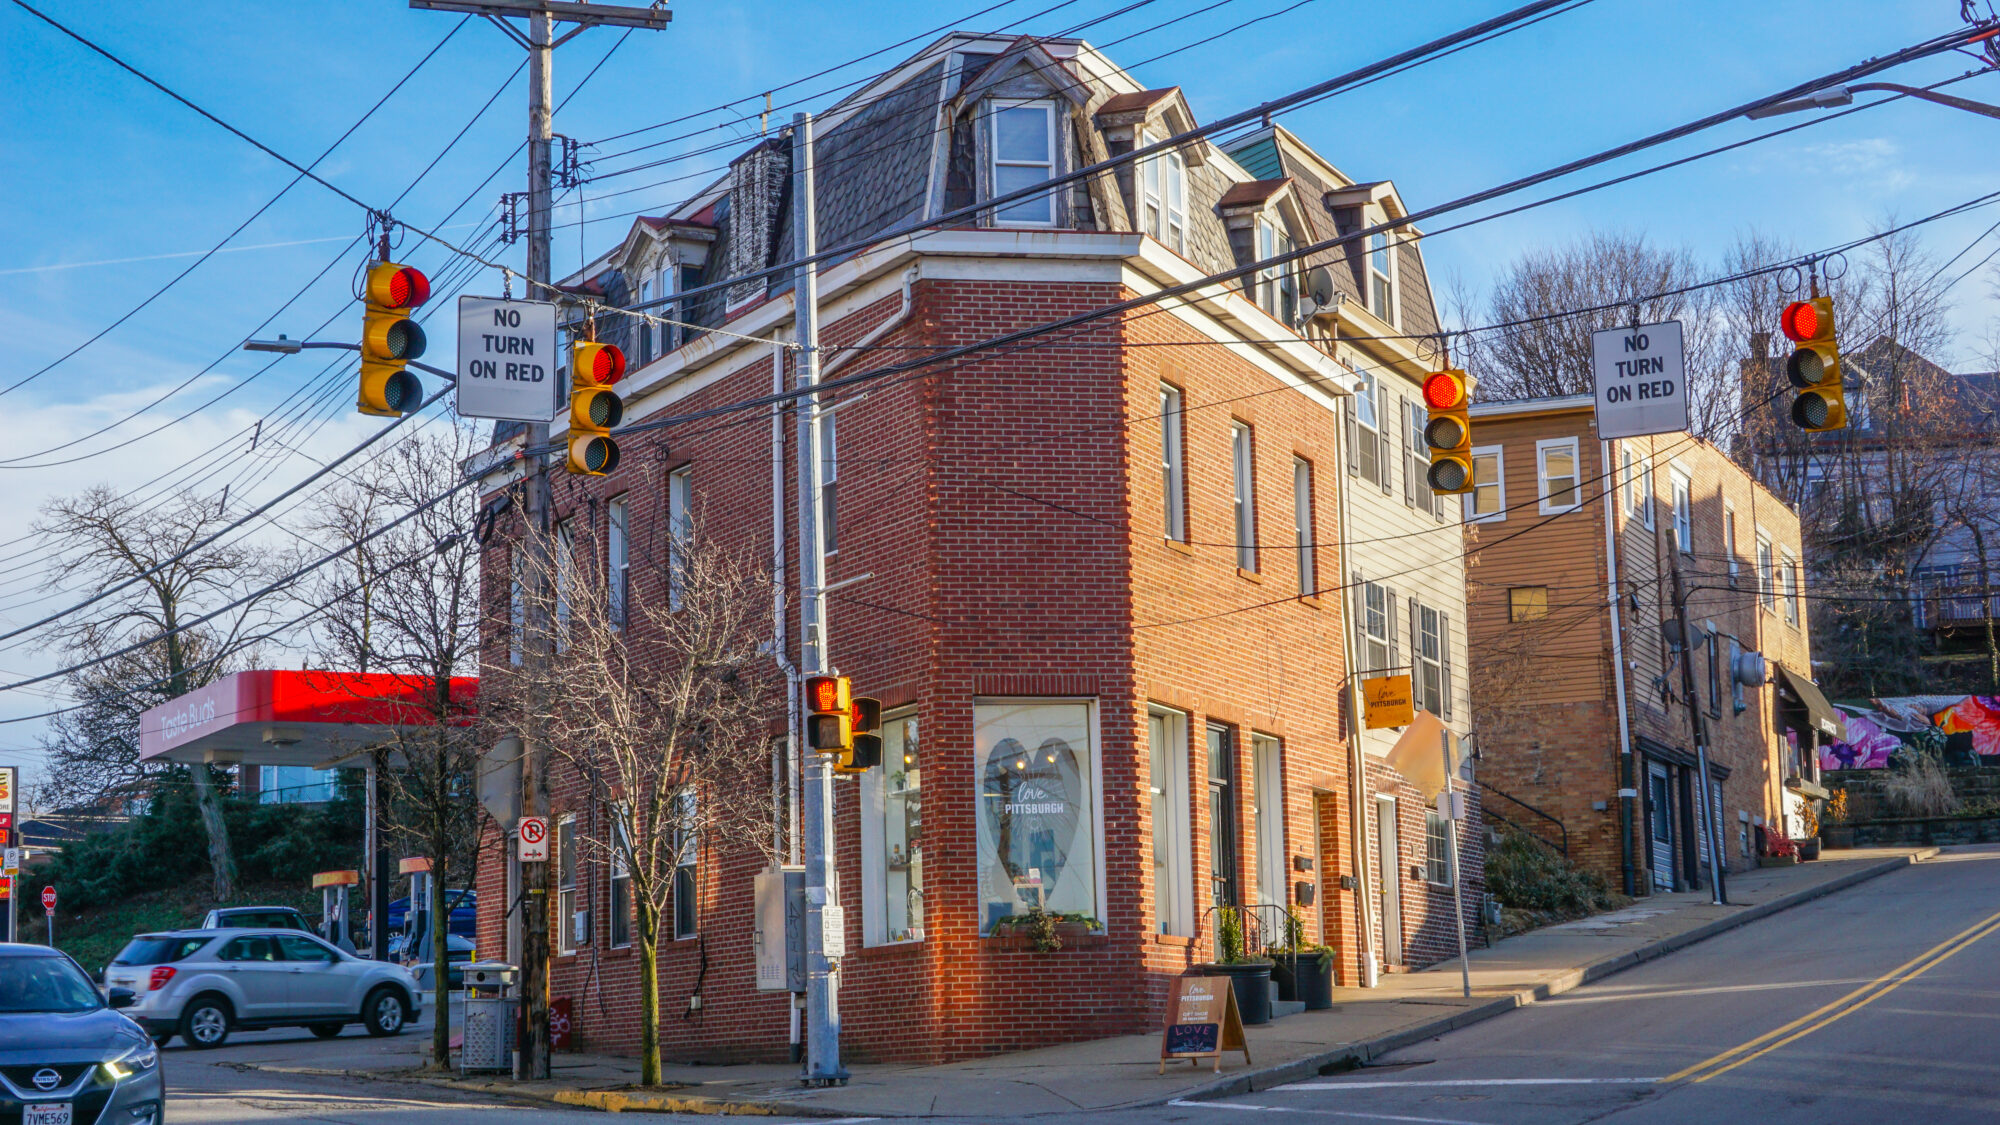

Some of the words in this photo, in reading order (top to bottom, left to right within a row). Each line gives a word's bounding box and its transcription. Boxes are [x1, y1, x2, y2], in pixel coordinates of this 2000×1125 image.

[494, 308, 521, 328] NO
[482, 334, 534, 356] TURN
[1624, 333, 1649, 352] NO
[469, 359, 497, 379] ON
[505, 363, 544, 383] RED
[1615, 356, 1664, 378] TURN
[1607, 384, 1632, 403] ON
[1638, 380, 1675, 400] RED
[1370, 698, 1407, 708] PITTSBURGH
[160, 707, 188, 742] Taste
[189, 695, 215, 729] Buds
[1005, 803, 1064, 815] PITTSBURGH
[43, 893, 56, 902] STOP
[1175, 1025, 1210, 1036] LOVE
[27, 1112, 69, 1125] 7VME569
